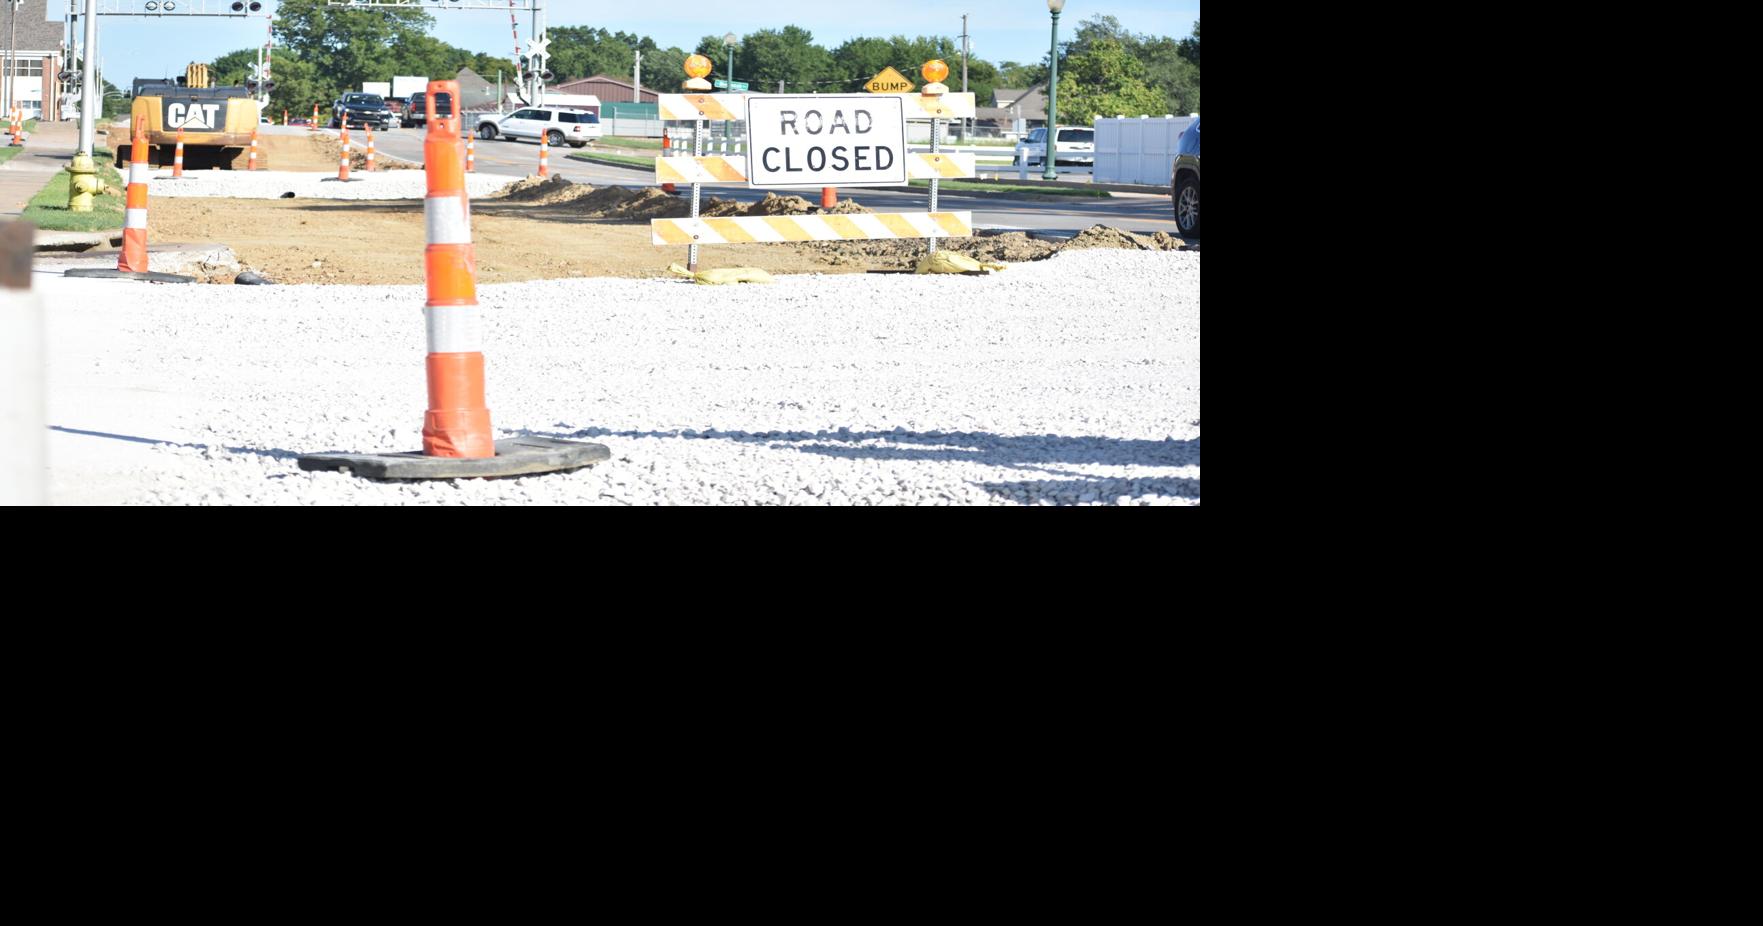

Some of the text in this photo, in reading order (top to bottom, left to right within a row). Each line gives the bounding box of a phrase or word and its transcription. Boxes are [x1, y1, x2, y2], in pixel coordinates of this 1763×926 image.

[872, 82, 908, 91] BUMP
[167, 102, 220, 129] CAT
[779, 109, 873, 135] ROAD
[762, 145, 894, 173] CLOSED
